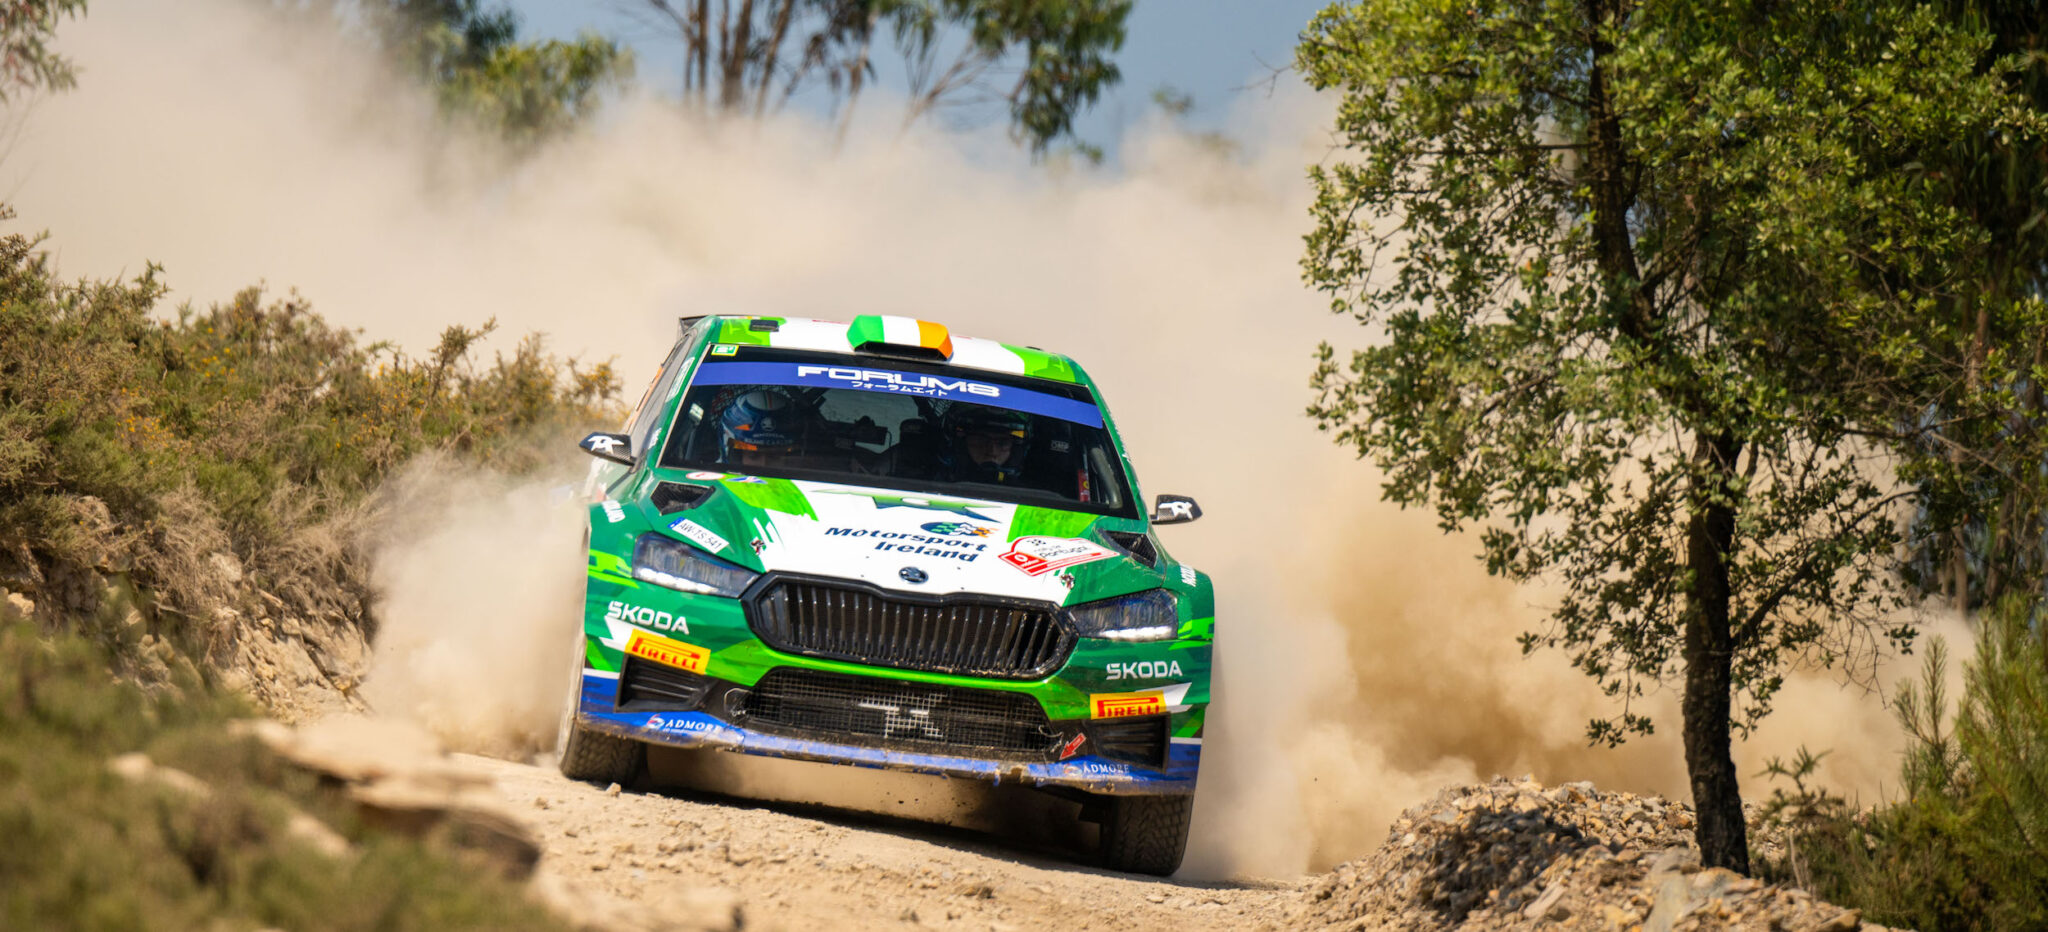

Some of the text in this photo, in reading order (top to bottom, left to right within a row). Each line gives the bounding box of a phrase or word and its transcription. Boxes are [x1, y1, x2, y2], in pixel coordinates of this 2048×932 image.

[798, 366, 1000, 397] FORUM8
[851, 381, 948, 396] フォーラムエイト
[704, 536, 722, 549] 541
[824, 527, 988, 551] Motorsport
[875, 541, 979, 562] Ireland
[632, 637, 701, 670] PIRELLI
[1097, 697, 1160, 717] PIRELLI
